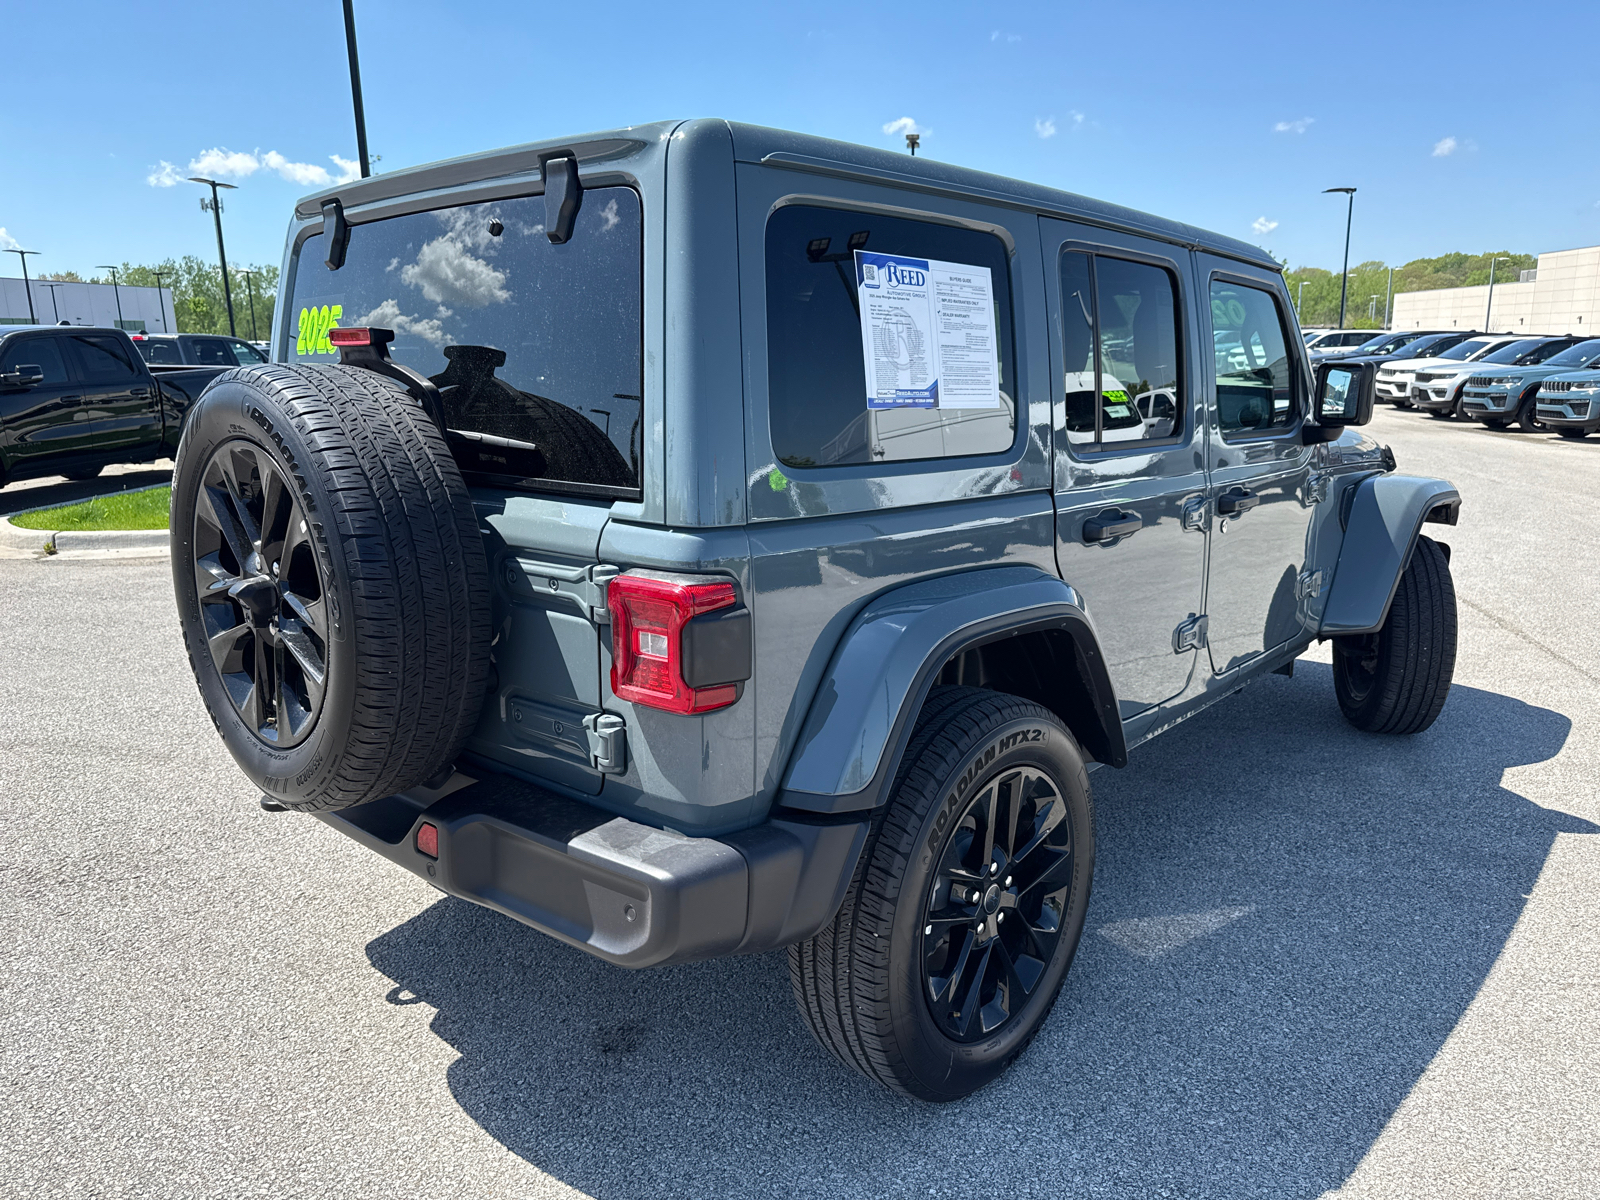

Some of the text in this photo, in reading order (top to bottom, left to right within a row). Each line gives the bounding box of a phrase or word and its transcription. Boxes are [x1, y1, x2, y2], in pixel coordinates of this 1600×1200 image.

[885, 262, 926, 288] REED
[296, 304, 343, 356] 2025
[927, 744, 996, 855] ROADIAN
[998, 728, 1043, 755] HTX2
